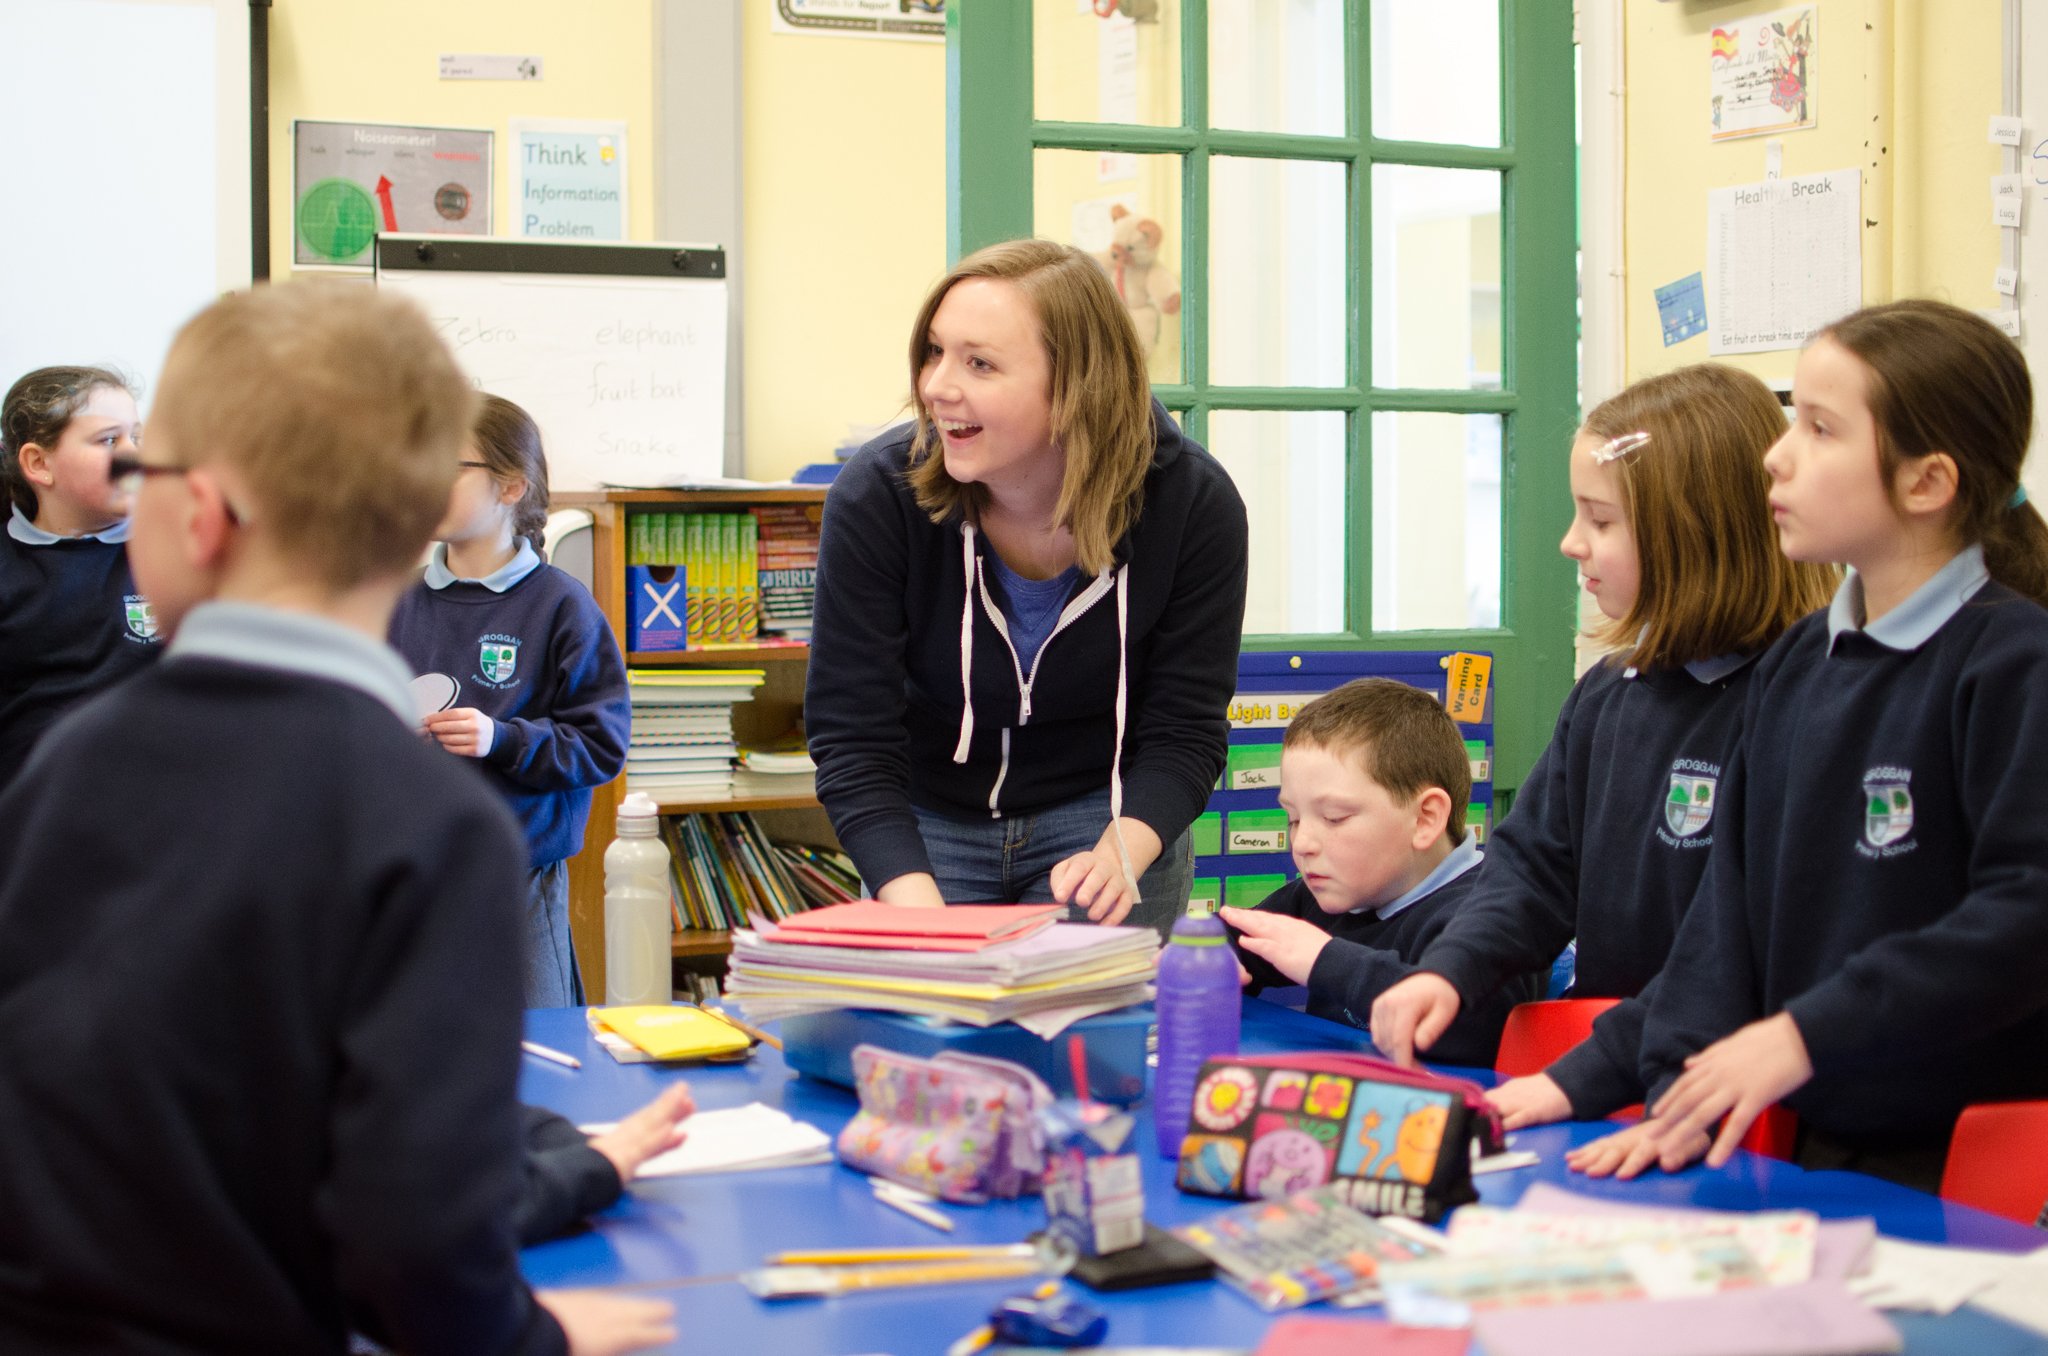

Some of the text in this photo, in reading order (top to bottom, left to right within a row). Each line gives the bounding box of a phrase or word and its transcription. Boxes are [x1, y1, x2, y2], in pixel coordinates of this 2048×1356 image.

[1995, 128, 2016, 137] Jessica
[523, 142, 588, 167] Think
[525, 178, 619, 205] Information
[1792, 177, 1833, 197] Break
[1999, 184, 2014, 194] Jack
[1999, 208, 2016, 220] Lucy
[525, 213, 596, 237] Problem
[595, 320, 697, 352] elephant
[1722, 334, 1733, 346] Eat
[1734, 333, 1749, 345] fruit
[1758, 331, 1777, 343] break
[1778, 331, 1792, 342] time
[1794, 330, 1805, 340] and
[587, 361, 687, 407] fruit bat
[1453, 657, 1473, 713] Warning
[1469, 673, 1483, 706] Card
[1227, 703, 1272, 724] Light
[1241, 770, 1267, 784] Jack
[1672, 759, 1720, 777] GROGGAN
[1233, 834, 1271, 847] Cameron
